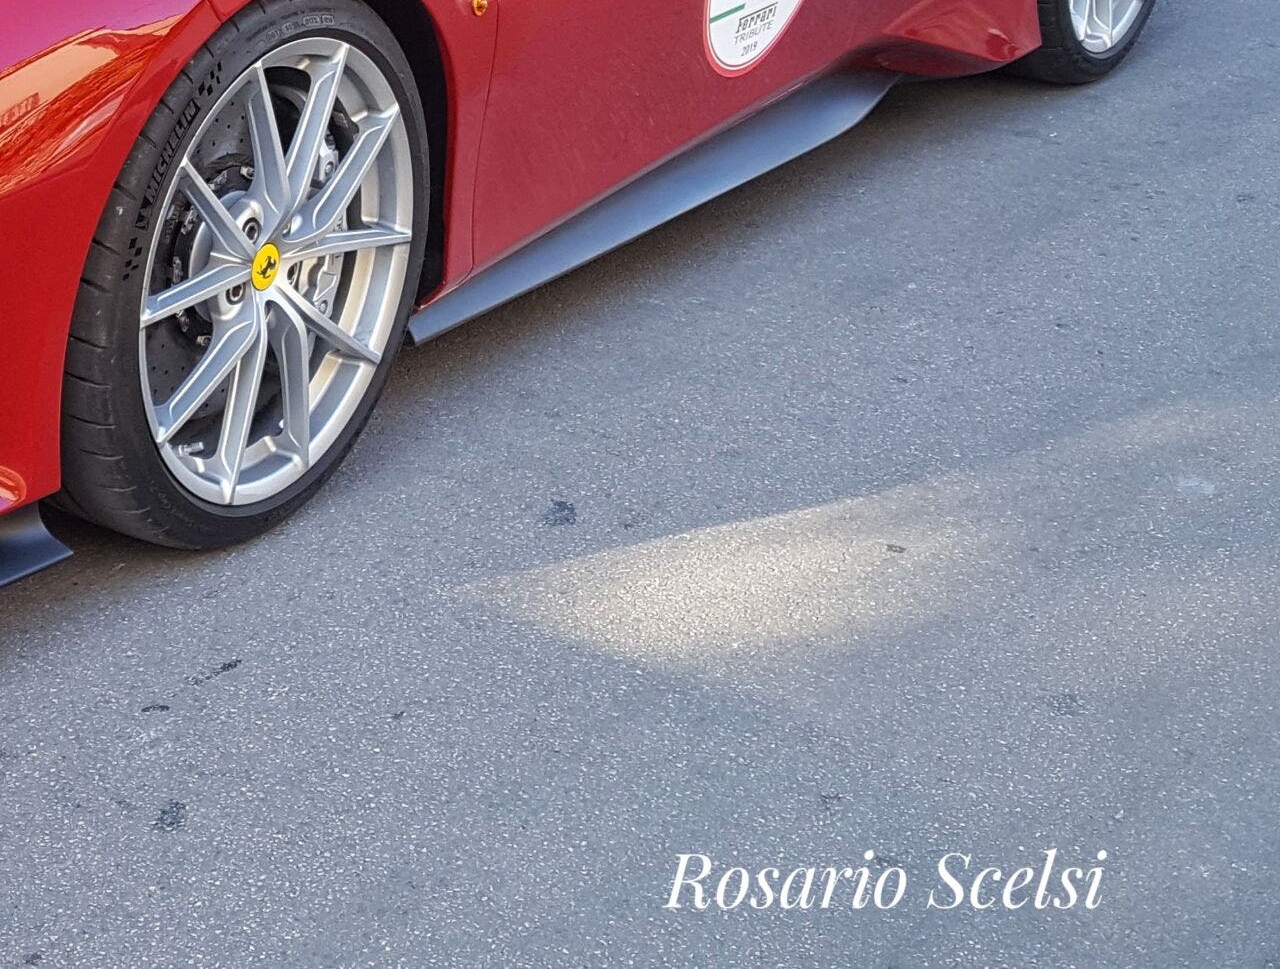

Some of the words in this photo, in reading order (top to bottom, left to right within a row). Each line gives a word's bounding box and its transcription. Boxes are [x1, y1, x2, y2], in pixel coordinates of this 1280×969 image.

[734, 19, 775, 45] TRIBUTE
[735, 2, 778, 34] Ferrari
[145, 98, 201, 205] MICHELIN
